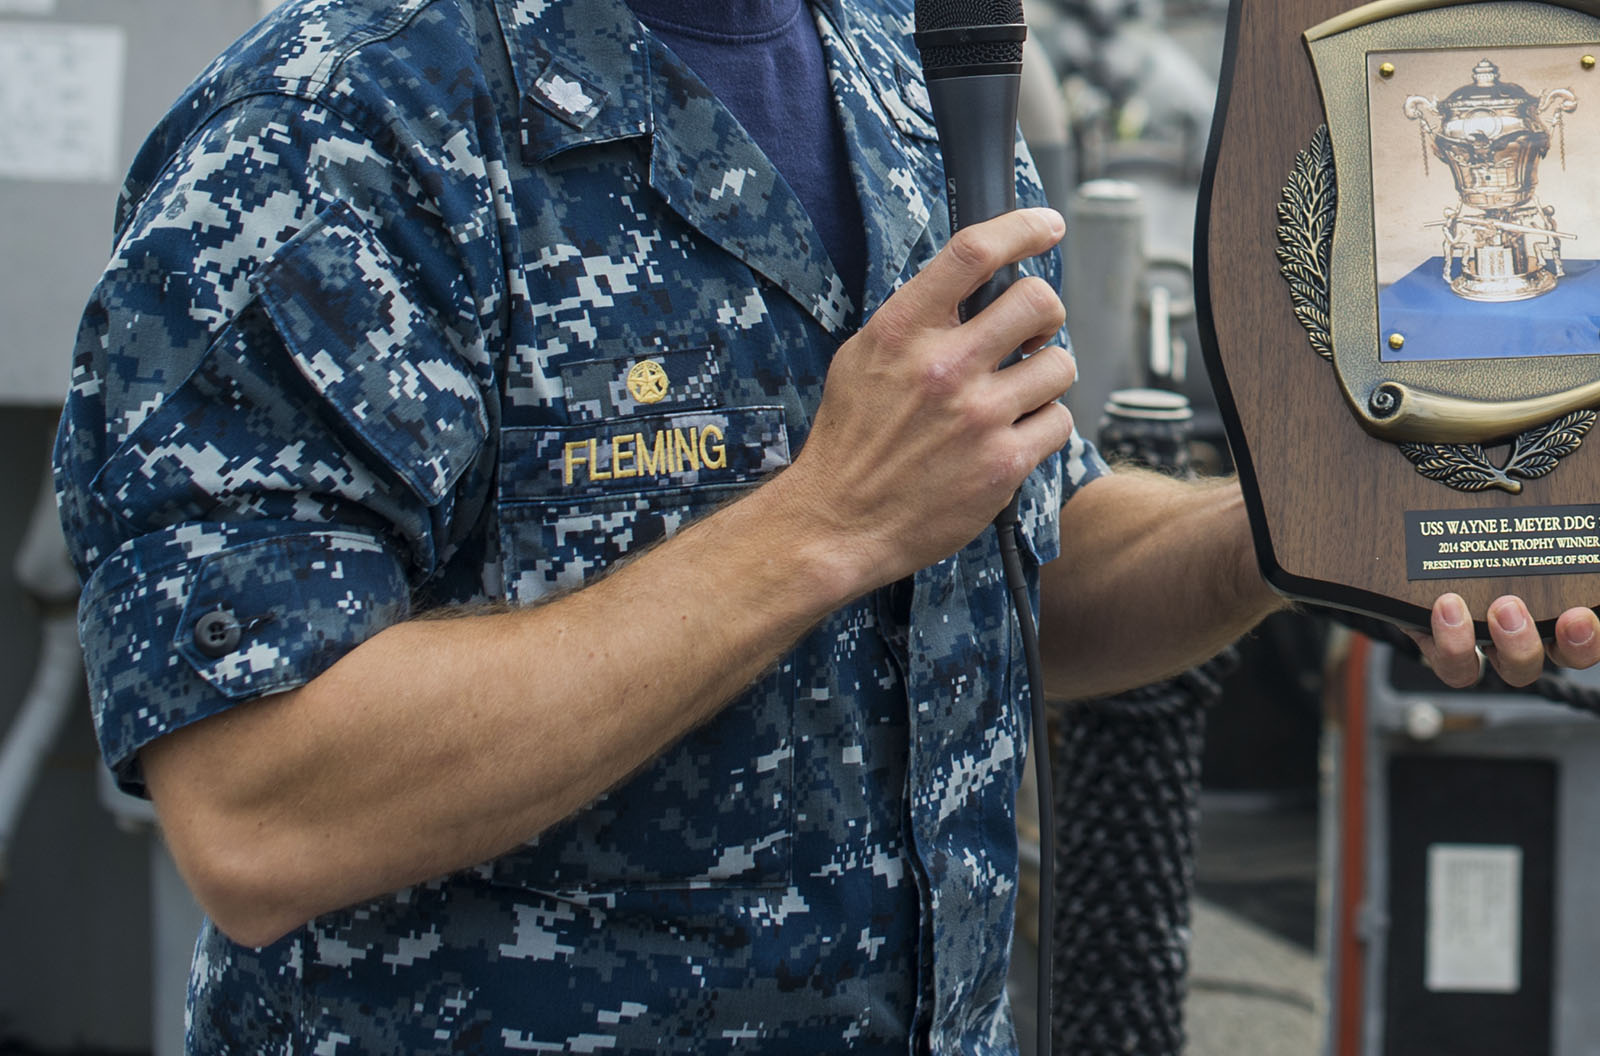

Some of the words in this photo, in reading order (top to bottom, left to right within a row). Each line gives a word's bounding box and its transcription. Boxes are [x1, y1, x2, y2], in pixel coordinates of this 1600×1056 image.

[564, 424, 727, 485] FLEMING
[1420, 521, 1444, 536] USS
[1446, 519, 1498, 534] WAYNE
[1499, 518, 1513, 533] E.
[1514, 517, 1562, 532] MEYER
[1563, 515, 1596, 530] DDG
[1438, 542, 1459, 553] 2014
[1460, 539, 1509, 552] SPOKANE
[1510, 537, 1555, 551] TROPHY
[1556, 536, 1600, 549] WINNER
[1423, 559, 1472, 570] PRESENTED
[1472, 558, 1485, 568] BY
[1485, 558, 1501, 567] U.S.
[1502, 556, 1528, 567] NAVY
[1528, 555, 1563, 566] LEAGUE
[1564, 555, 1577, 564] OF
